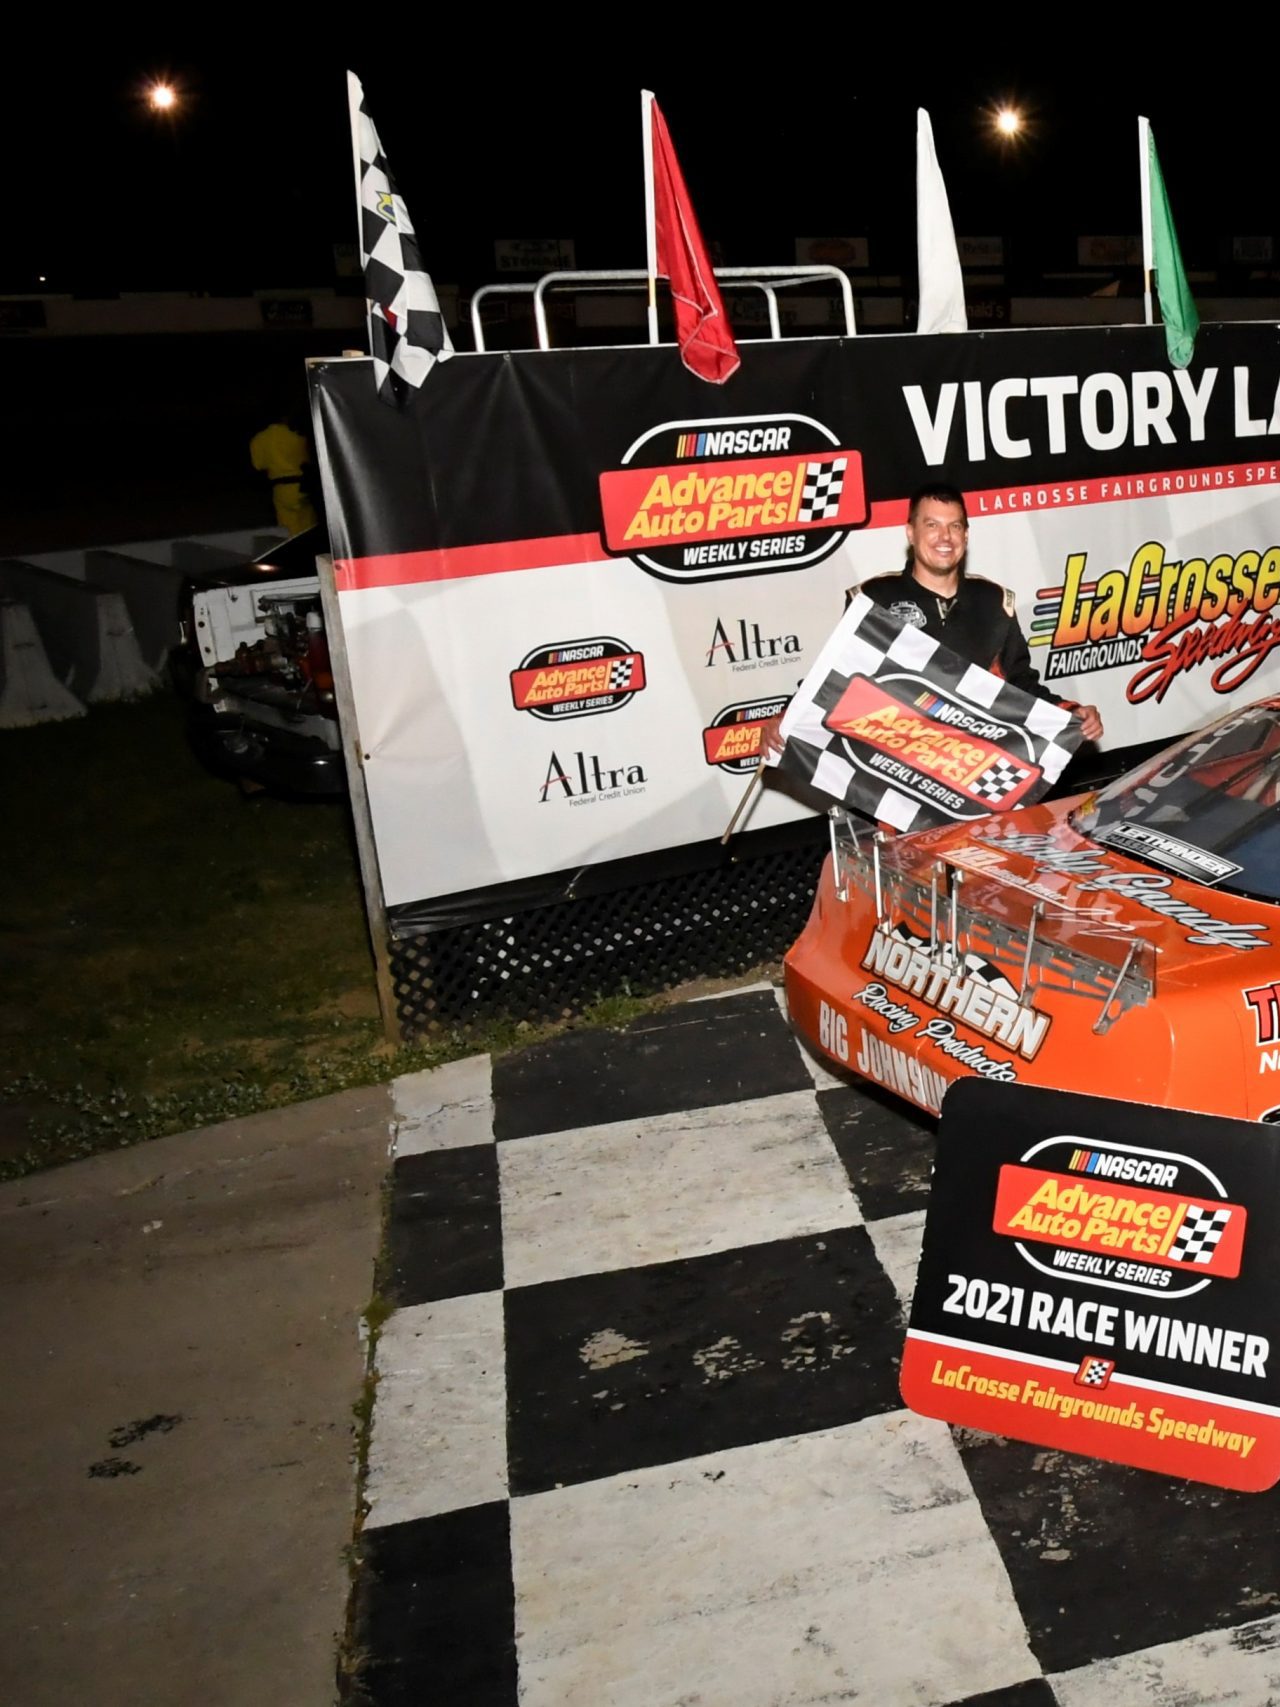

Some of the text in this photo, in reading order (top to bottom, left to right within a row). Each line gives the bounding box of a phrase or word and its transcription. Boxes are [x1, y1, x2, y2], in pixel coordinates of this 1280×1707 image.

[903, 367, 1217, 467] VICTORY
[705, 427, 791, 456] NASCAR
[641, 470, 793, 510] Advance
[979, 485, 1089, 512] LACROSSE
[1101, 469, 1236, 497] FAIRGROUNDS
[624, 499, 789, 541] Auto Parts
[683, 535, 806, 566] WEEKLY SERIES
[561, 645, 604, 663] NASCAR
[704, 617, 804, 668] Altra
[1049, 637, 1143, 677] FAIRGROUNDS
[533, 664, 606, 687] Advance
[732, 655, 802, 673] Federal Credit Union
[524, 679, 604, 703] Auto Parts
[552, 695, 613, 714] WEEKLY SERIES
[721, 726, 761, 745] Adva
[863, 704, 985, 765] Advance
[935, 704, 1008, 740] NASCAR
[715, 742, 750, 759] Auto
[843, 716, 967, 781] Auto Parts
[538, 751, 649, 803] Altra
[569, 786, 646, 808] Federal Credit Union
[869, 752, 965, 810] WEEKLY SERIES
[1113, 825, 1234, 876] LEFTHANDER
[862, 929, 1051, 1061] NORTHERN
[853, 982, 1018, 1081] Racing Products
[819, 1000, 949, 1111] BIG JOHNSON
[1094, 1153, 1179, 1188] NASCAR
[1028, 1179, 1173, 1230] Advance
[1008, 1205, 1161, 1254] Auto Parts
[1053, 1250, 1173, 1288] WEEKLY SERIES
[942, 1274, 1270, 1378] 2021 RACE WINNER
[931, 1359, 1257, 1457] LaCrosse Fairgrounds Speedway
